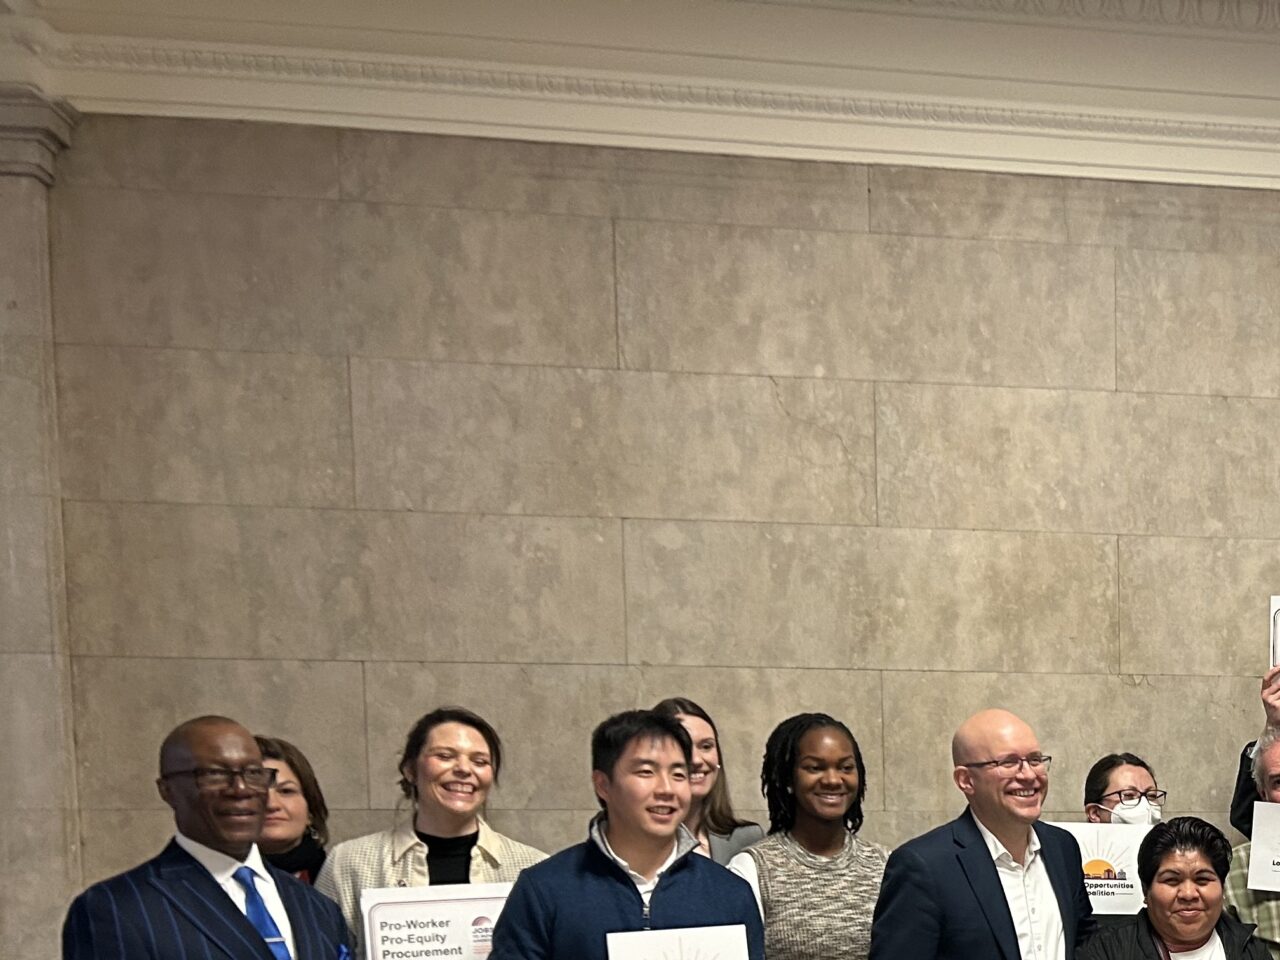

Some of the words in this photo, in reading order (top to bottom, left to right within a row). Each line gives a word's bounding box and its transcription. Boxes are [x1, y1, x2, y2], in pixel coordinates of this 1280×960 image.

[380, 920, 450, 931] Pro-Worker
[381, 934, 447, 945] Pro-Equity
[383, 946, 463, 959] Procurement
